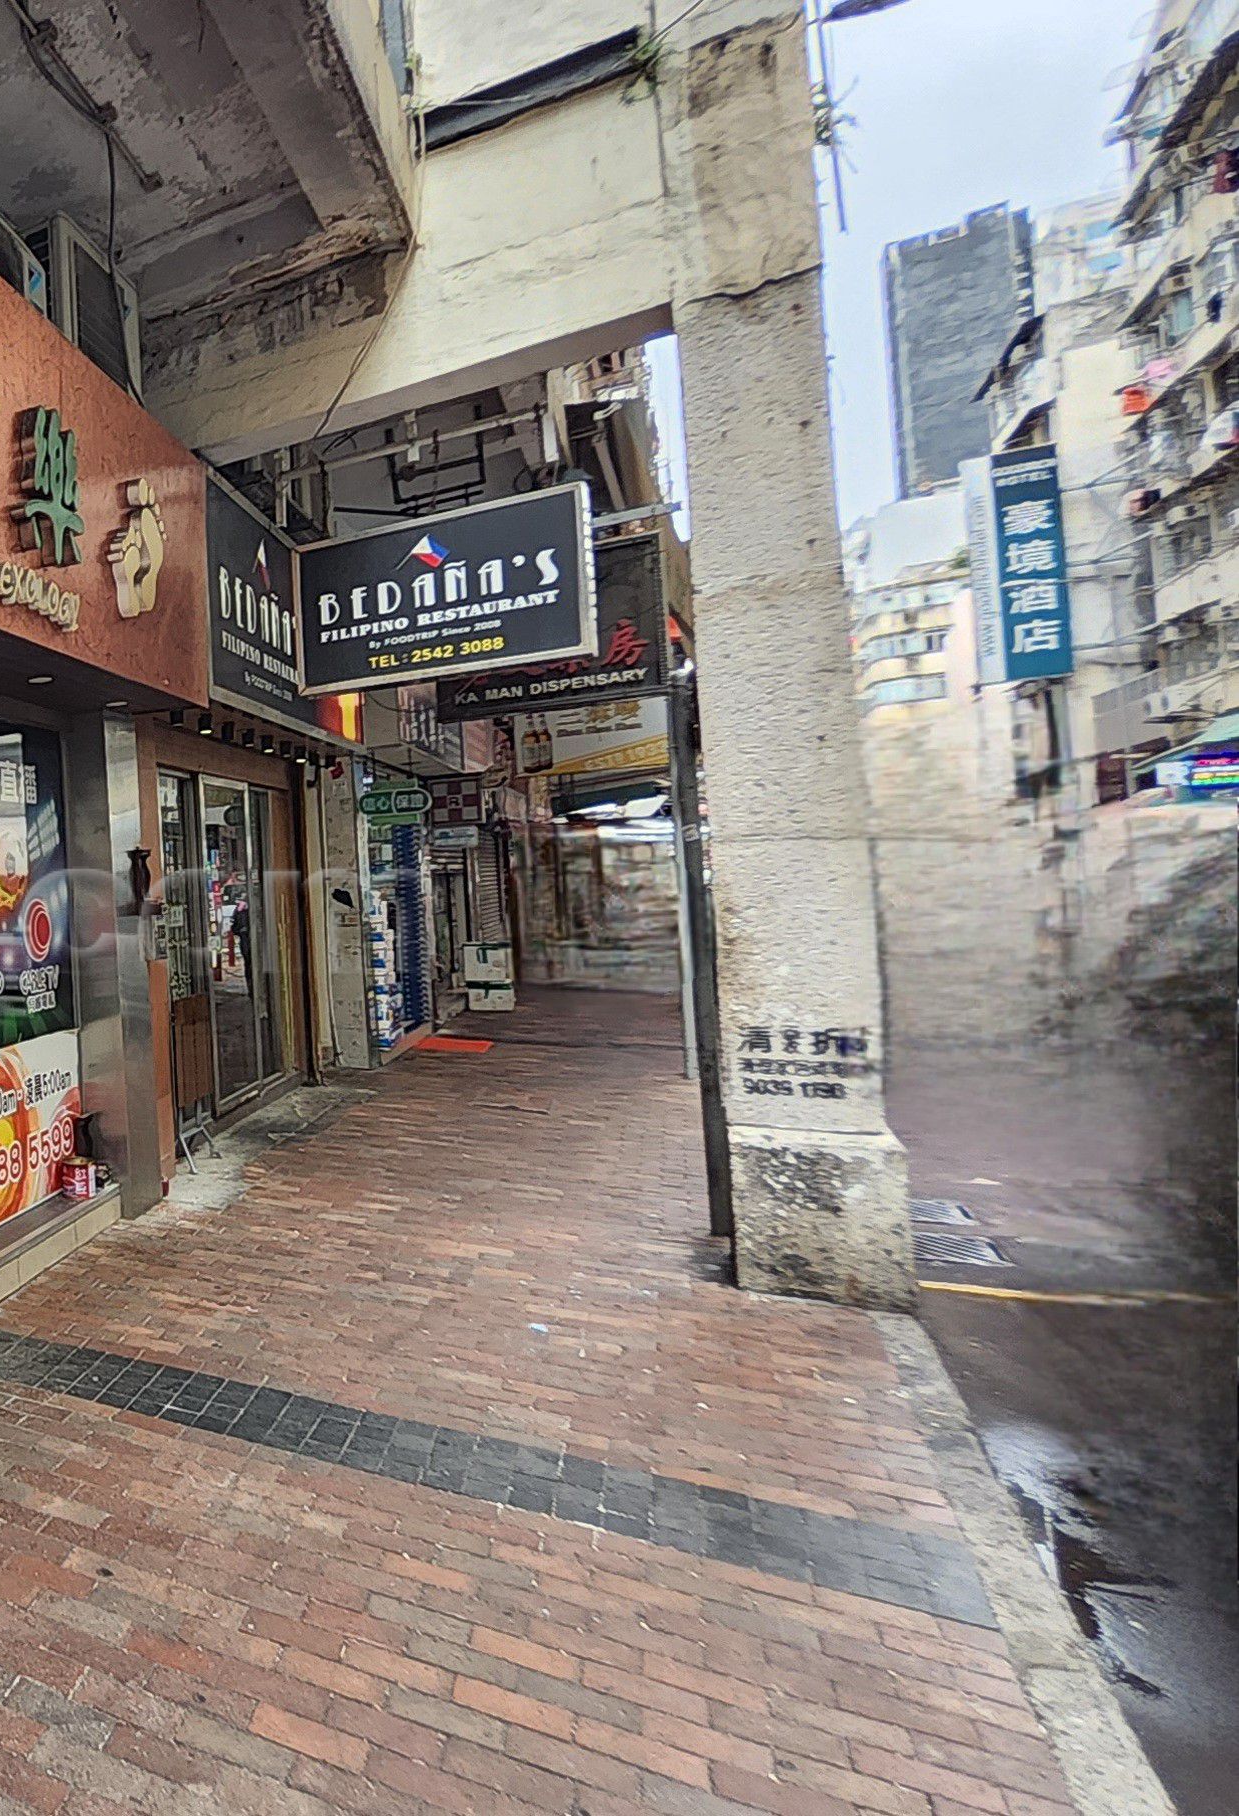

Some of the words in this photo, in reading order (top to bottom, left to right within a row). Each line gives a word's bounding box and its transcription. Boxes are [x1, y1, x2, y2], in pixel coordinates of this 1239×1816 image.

[318, 547, 561, 626] BEDAÑA'S
[320, 616, 410, 644] FILIPINO
[417, 589, 560, 627] RESTAURANT
[221, 629, 262, 666] FILIPINO
[368, 640, 381, 650] By
[383, 628, 440, 646] FOODTRIP
[441, 624, 472, 638] Since
[410, 644, 454, 664] 2542
[459, 636, 505, 656] 3088
[454, 692, 479, 707] KA
[485, 684, 523, 702] MAN
[529, 667, 649, 696] DISPENSARY
[27, 1117, 74, 1171] 5599
